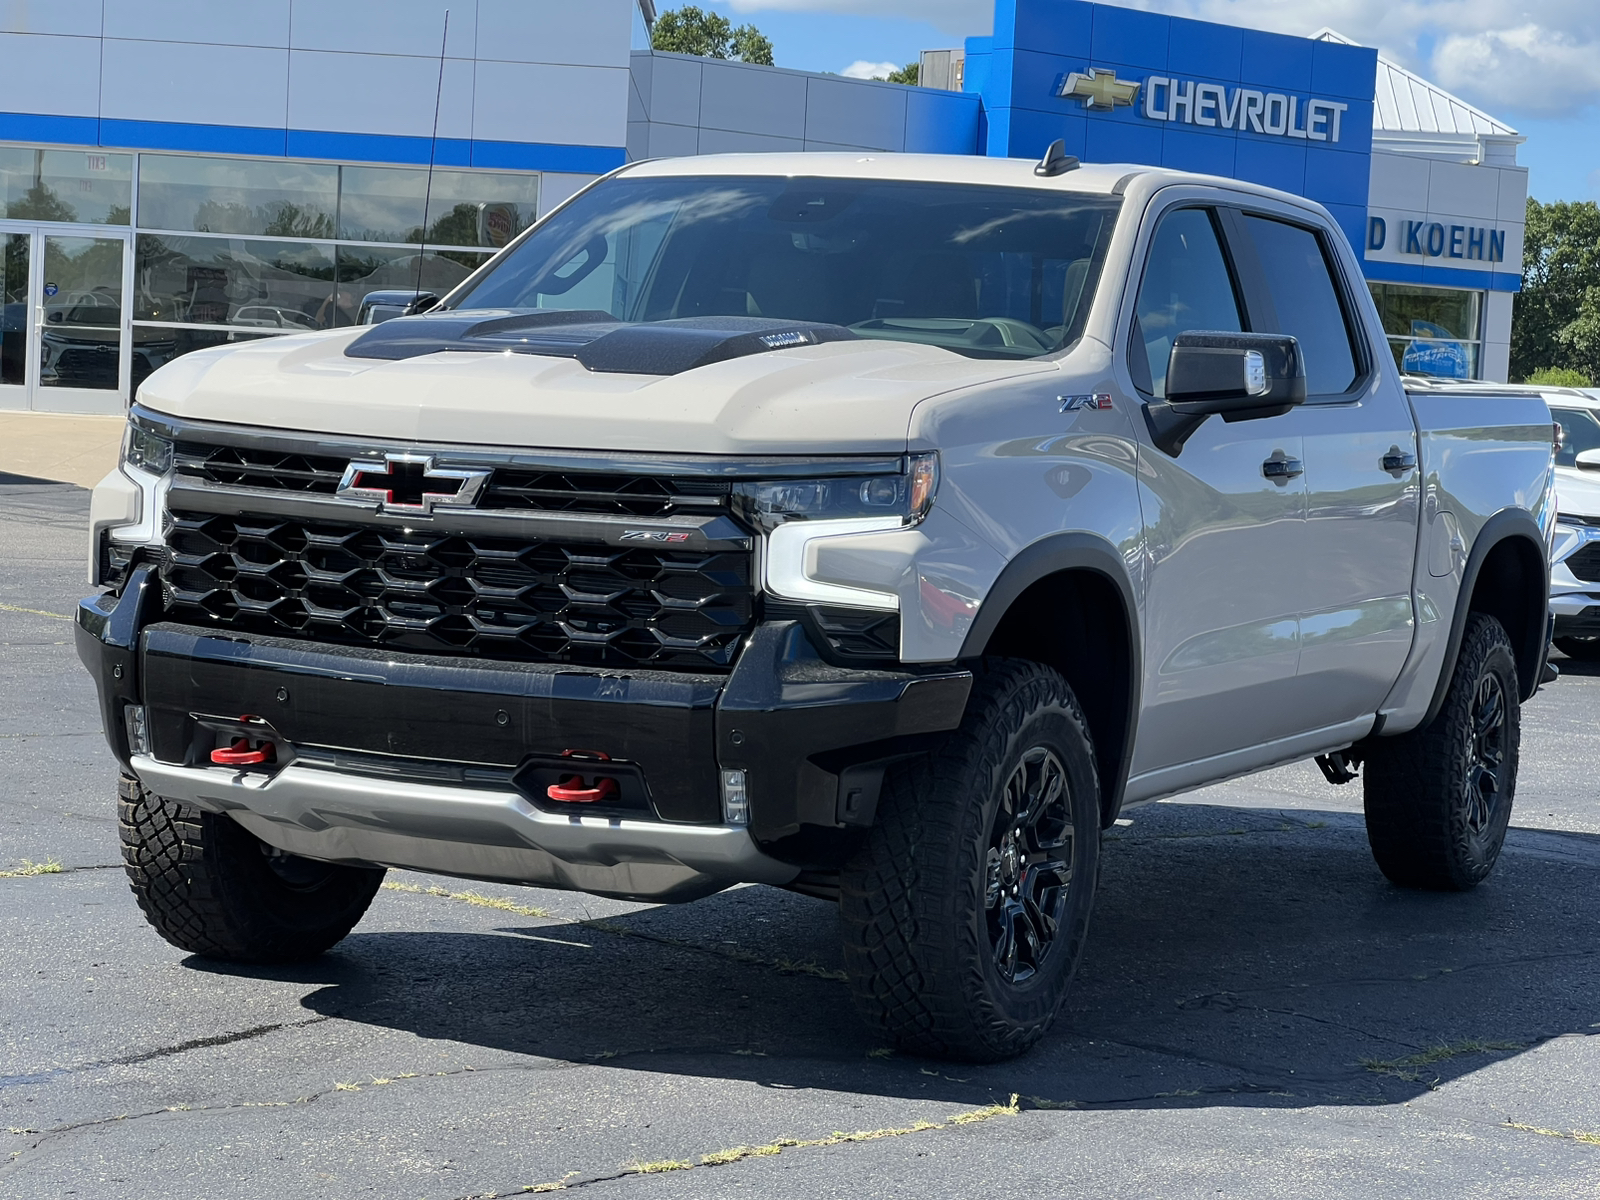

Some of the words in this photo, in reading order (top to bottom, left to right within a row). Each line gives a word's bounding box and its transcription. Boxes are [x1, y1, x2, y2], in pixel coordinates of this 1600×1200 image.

[1145, 76, 1347, 142] CHEVROLET
[1401, 219, 1506, 263] KOEHN
[1057, 393, 1113, 414] ZR2
[619, 529, 689, 544] ZR2
